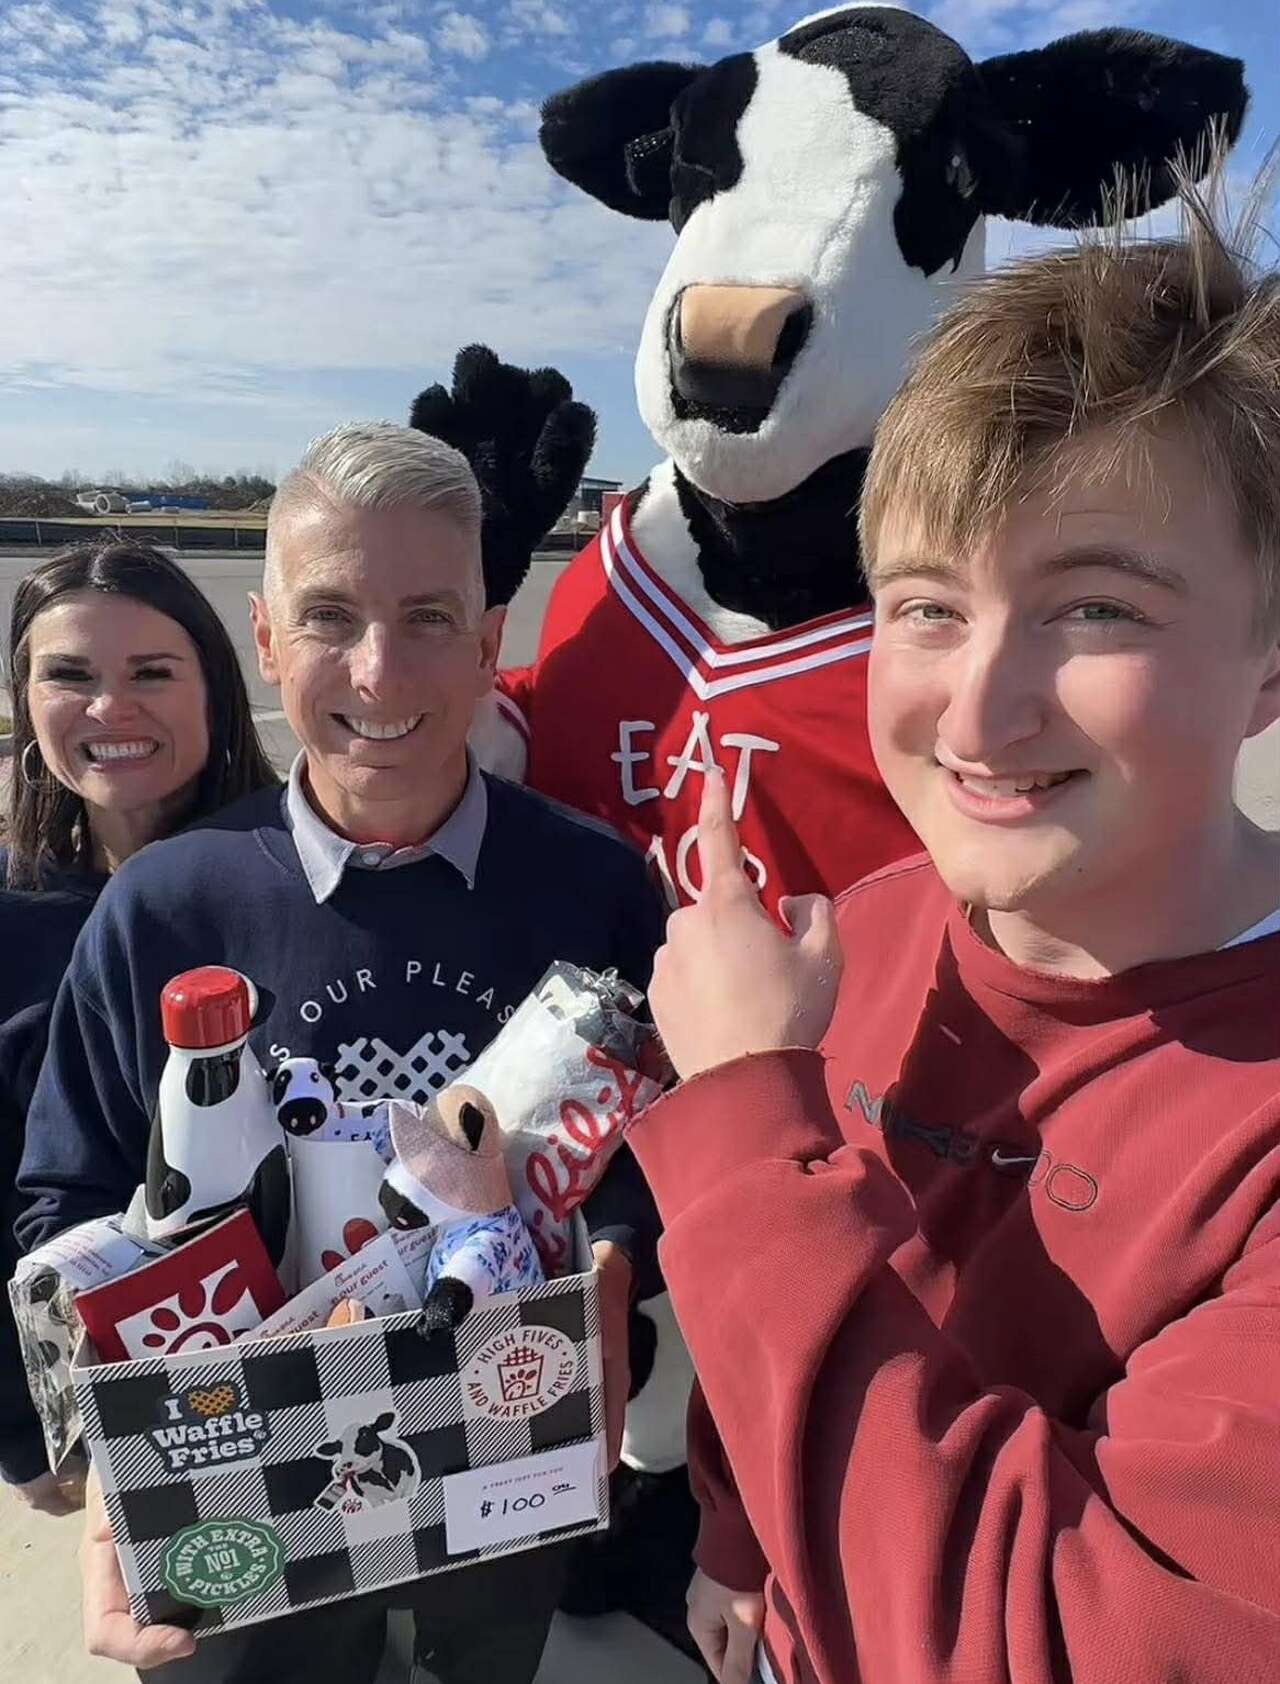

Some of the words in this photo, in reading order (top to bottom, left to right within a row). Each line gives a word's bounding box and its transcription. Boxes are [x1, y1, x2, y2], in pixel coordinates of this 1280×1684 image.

[611, 710, 780, 821] EAT
[300, 969, 377, 1023] OUR
[360, 1259, 389, 1286] guest
[477, 1333, 516, 1365] HIGH
[523, 1329, 563, 1351] FIVES
[467, 1381, 489, 1407] AND
[488, 1395, 546, 1418] WAFFLE
[547, 1360, 573, 1398] FRIES
[164, 1398, 183, 1420] I
[152, 1411, 263, 1448] Waffle
[168, 1437, 256, 1468] Fries
[175, 1535, 209, 1577] WITH
[209, 1528, 268, 1558] EXTRA
[188, 1563, 267, 1595] PICKLES
